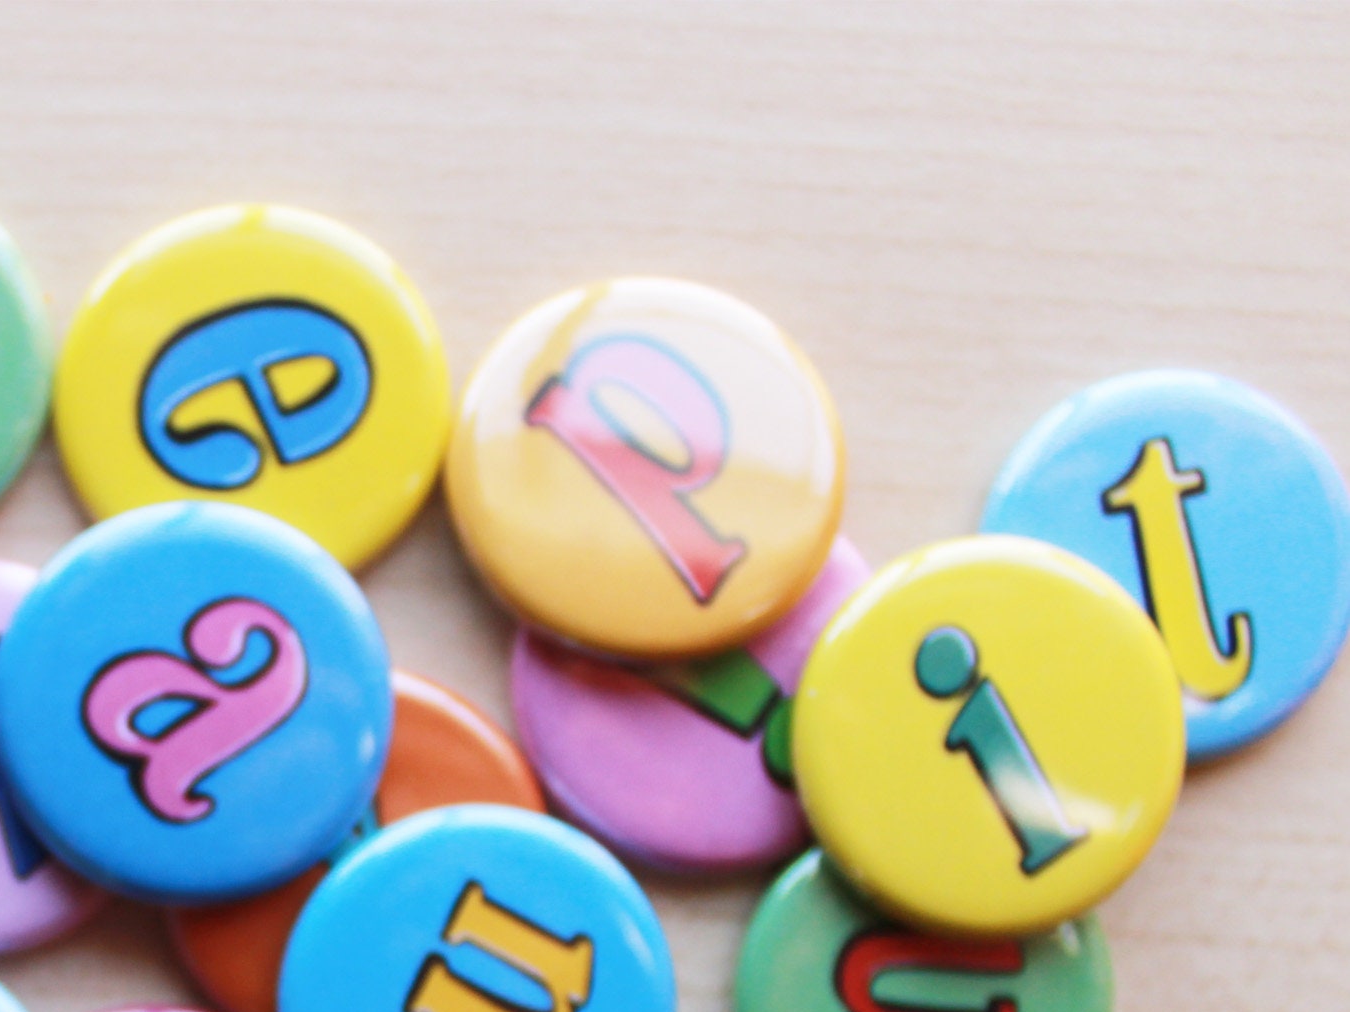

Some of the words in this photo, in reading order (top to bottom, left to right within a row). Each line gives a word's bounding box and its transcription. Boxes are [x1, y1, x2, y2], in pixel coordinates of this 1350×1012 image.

[136, 296, 374, 491] e
[1100, 437, 1252, 702] t
[80, 595, 310, 824] a
[914, 624, 1090, 877] i
